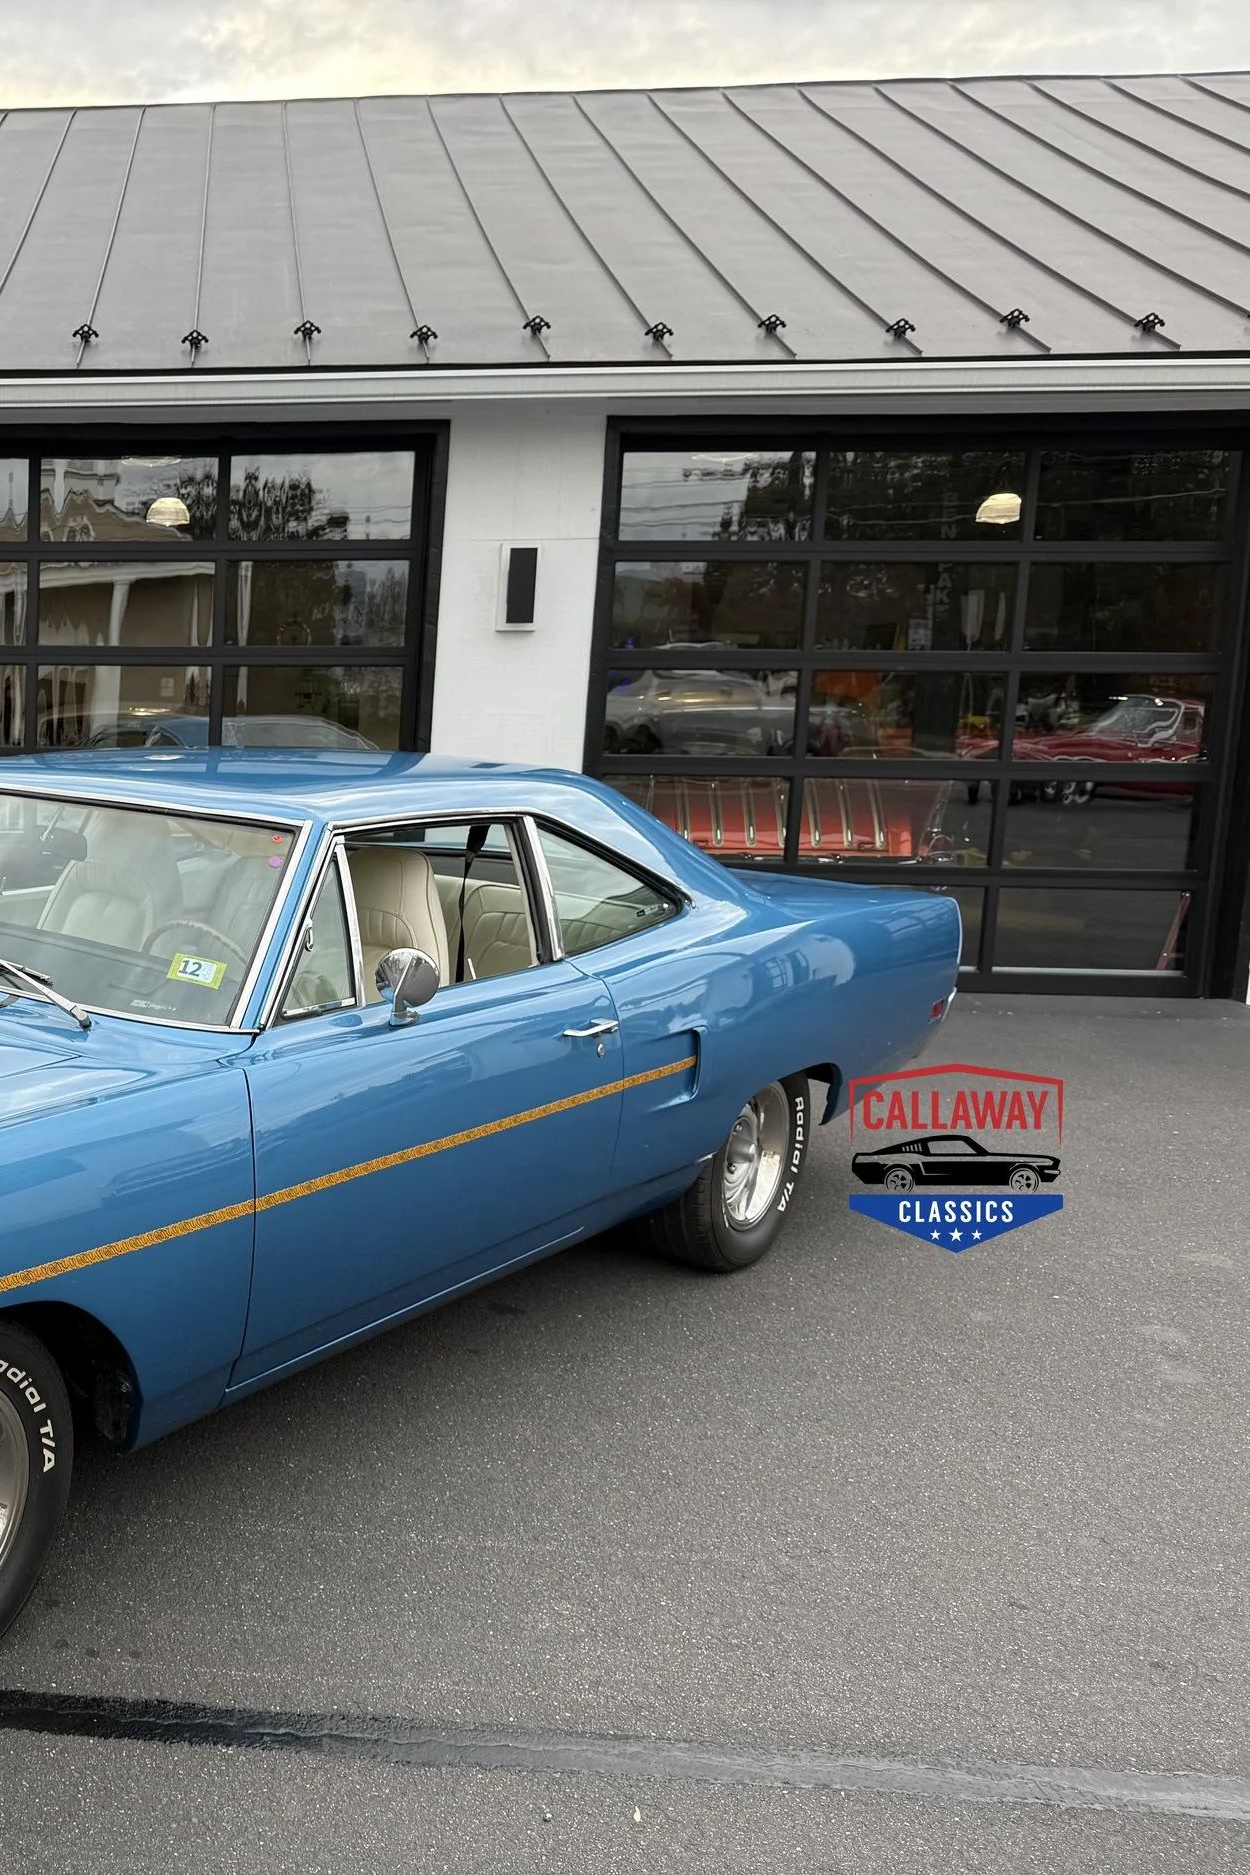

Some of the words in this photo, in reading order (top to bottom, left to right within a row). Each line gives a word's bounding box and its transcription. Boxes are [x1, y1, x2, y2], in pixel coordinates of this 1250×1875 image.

[936, 492, 959, 604] BENPAK
[178, 960, 202, 977] 12
[791, 1096, 805, 1173] Radial
[777, 1181, 794, 1212] T/A
[39, 1419, 56, 1473] T/A
